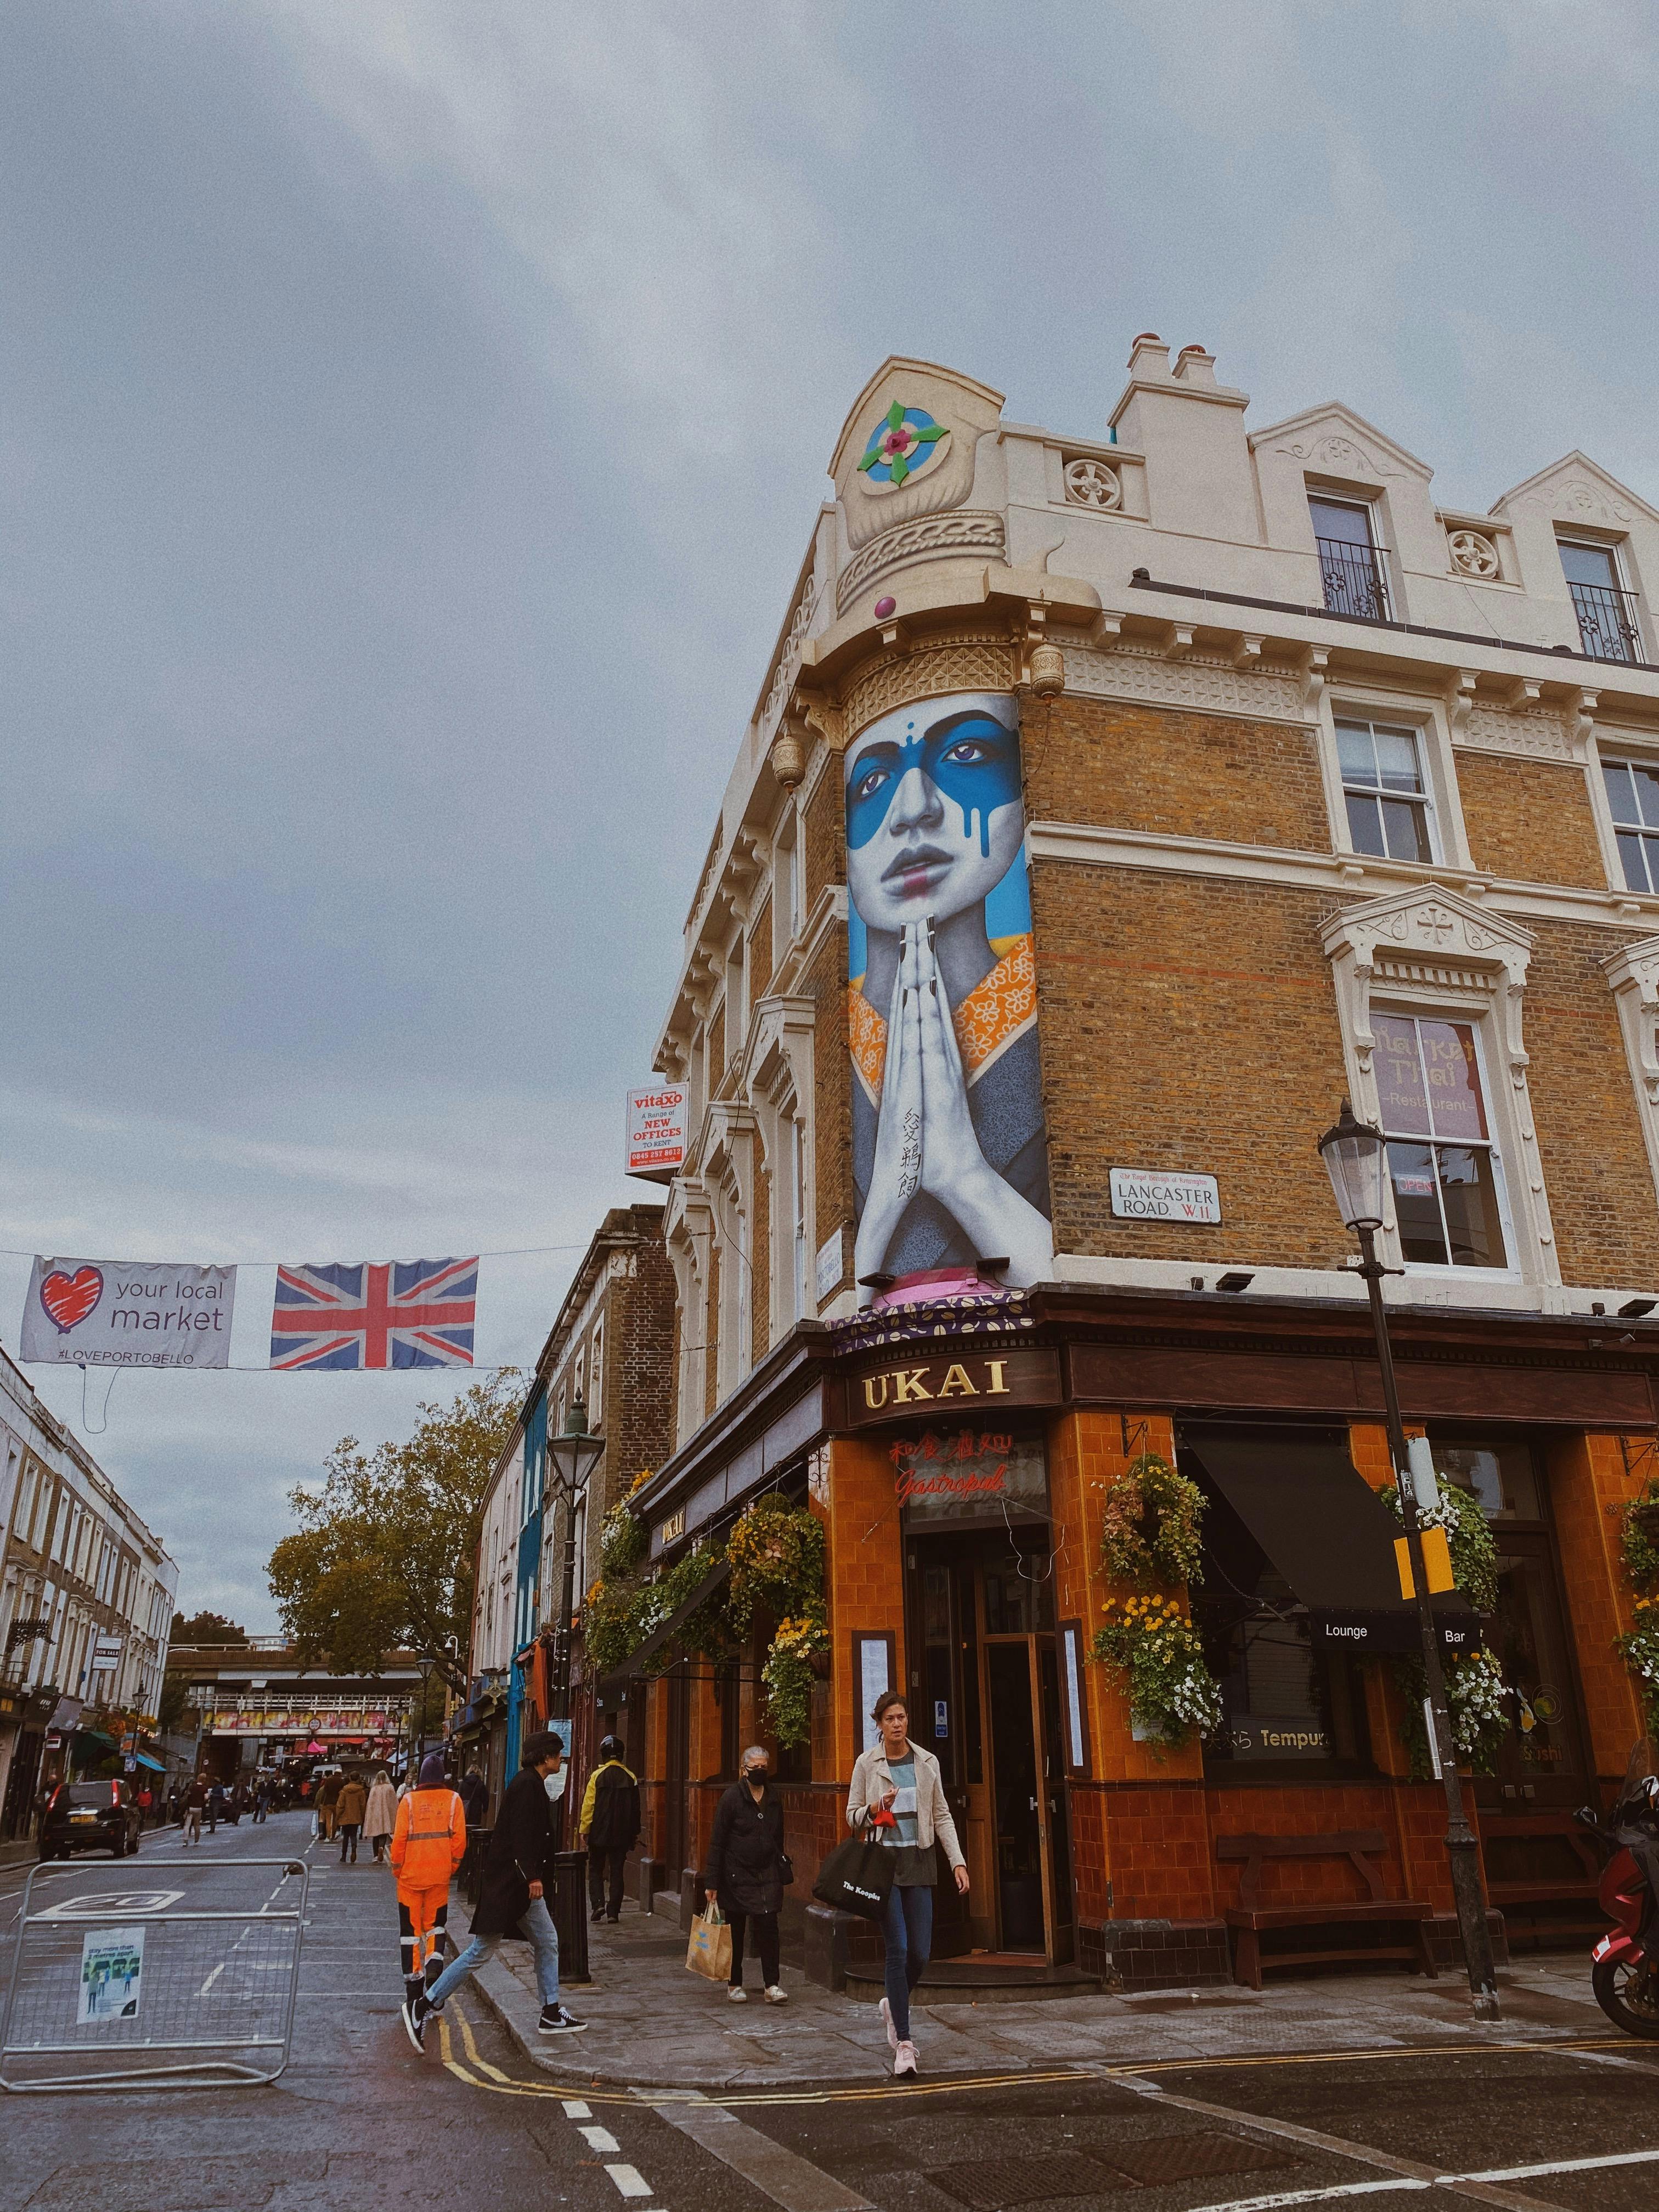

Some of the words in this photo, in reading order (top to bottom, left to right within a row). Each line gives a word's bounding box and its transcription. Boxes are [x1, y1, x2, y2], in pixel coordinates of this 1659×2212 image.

[635, 1094, 682, 1108] vitaxo
[644, 1118, 671, 1129] NEW
[633, 1127, 681, 1141] OFFICES
[1118, 1184, 1214, 1204] LANCASTER
[1397, 1177, 1433, 1193] OPEN
[116, 1280, 167, 1300] your
[176, 1280, 223, 1300] local
[111, 1306, 223, 1332] market
[58, 1349, 194, 1364] #LOVEPORTOBELLO
[862, 1361, 1011, 1409] UKAI
[895, 1463, 1007, 1508] Gastropub
[1326, 1624, 1368, 1639] Lounge
[1445, 1630, 1465, 1643] Bar
[1261, 1730, 1330, 1750] Tempur
[843, 1881, 854, 1891] The
